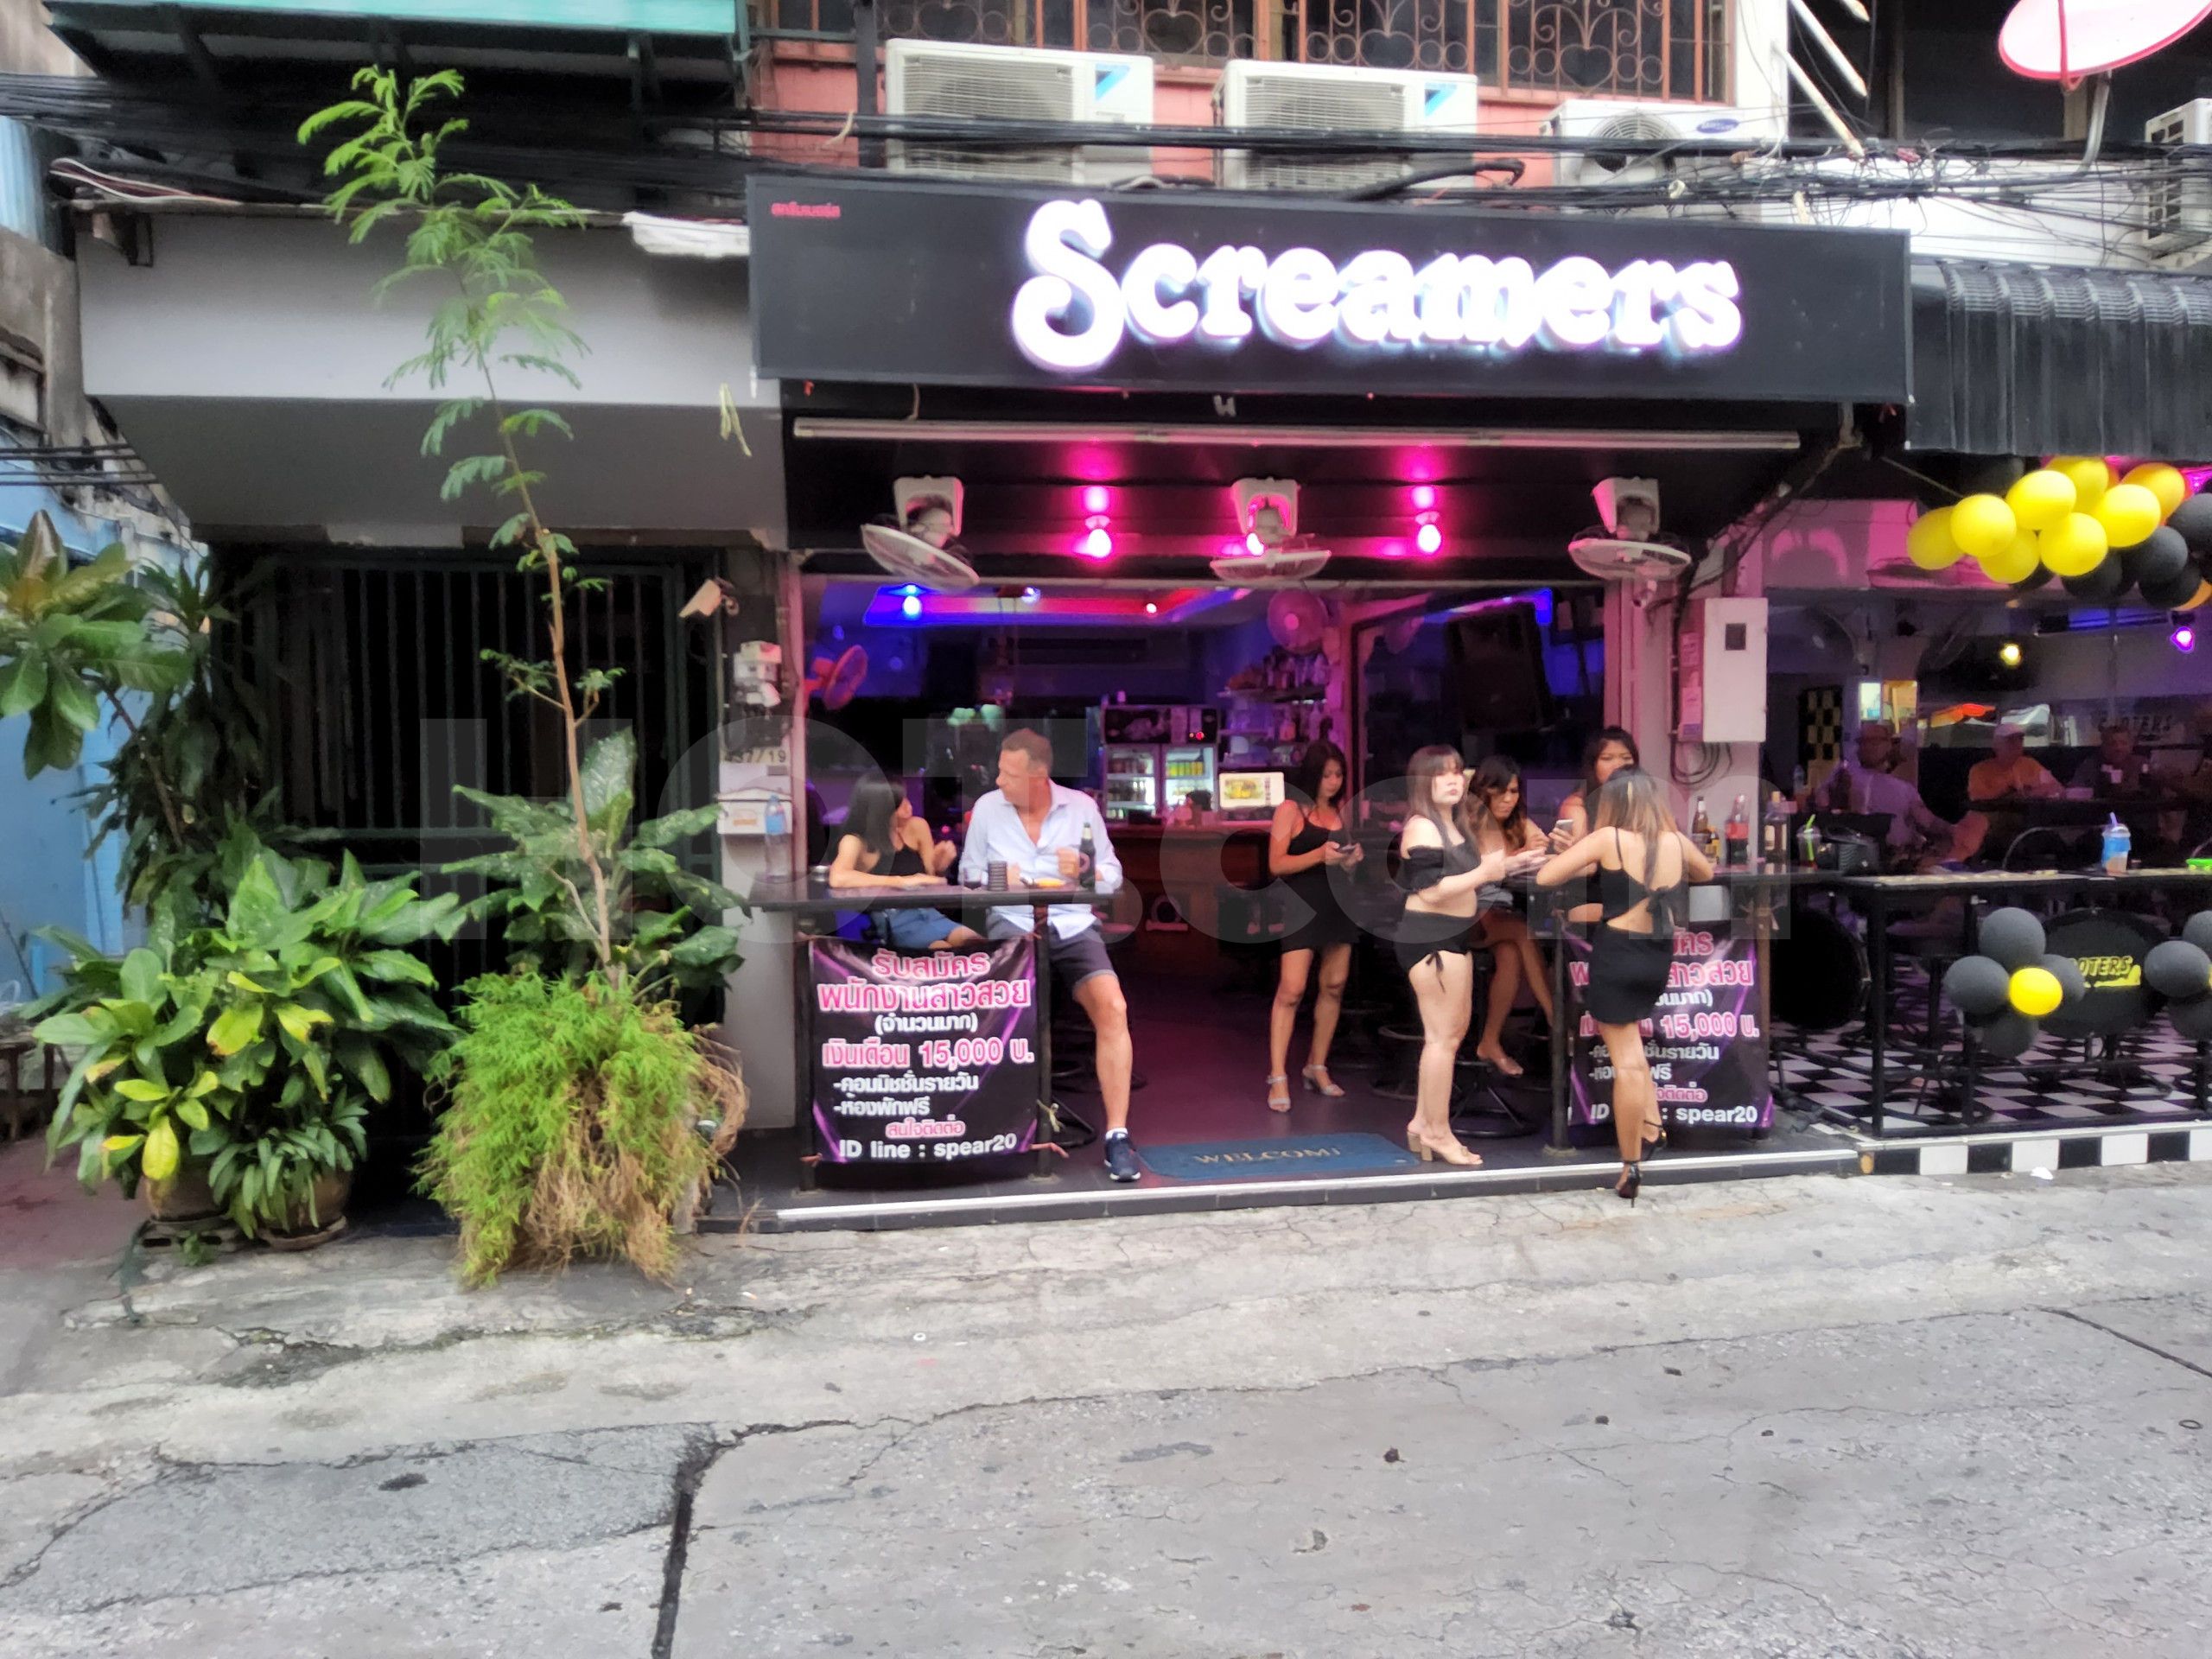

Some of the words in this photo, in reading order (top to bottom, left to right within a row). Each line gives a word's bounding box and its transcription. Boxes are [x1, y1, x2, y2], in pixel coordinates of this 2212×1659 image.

[1013, 199, 1741, 372] Screamers
[872, 948, 990, 980] รับสมัคร
[817, 976, 1031, 1013] พนักงานสาวสวย
[874, 1013, 978, 1035] (จำนวนมาก)
[1660, 1012, 1737, 1040] 15,000
[823, 1037, 910, 1068] เงินเดือน
[918, 1037, 1004, 1071] 15,000
[885, 1114, 966, 1139] สนใจติดต่อ
[1591, 1103, 1610, 1121] ID
[1675, 1106, 1758, 1125] spear20
[838, 1140, 863, 1158] ID
[870, 1140, 911, 1159] line
[933, 1133, 1017, 1160] spear20
